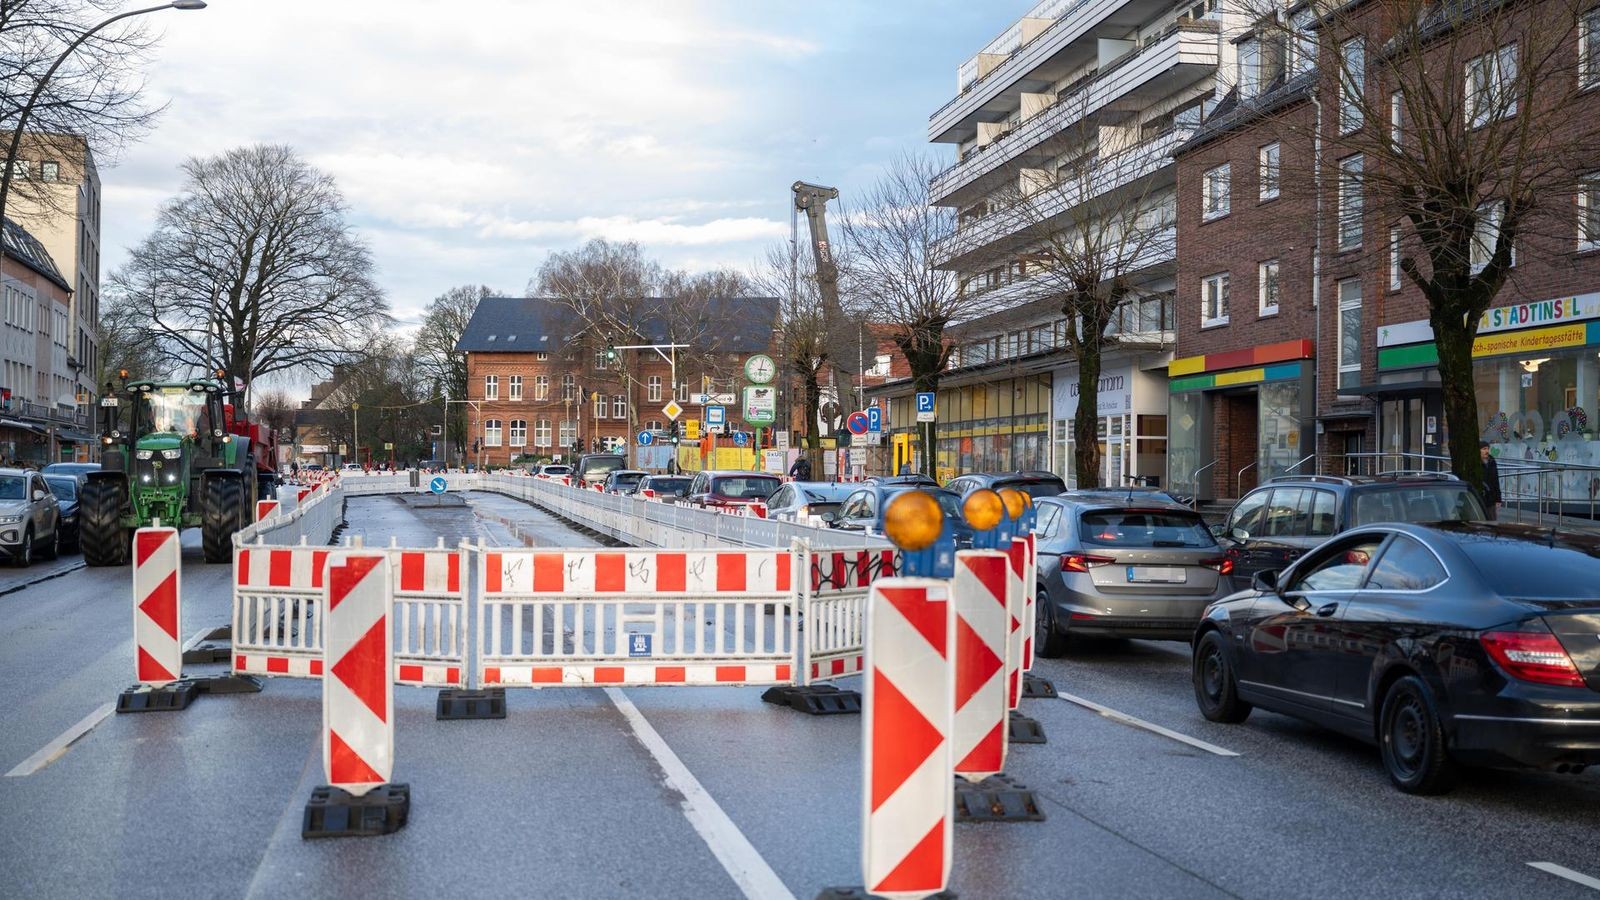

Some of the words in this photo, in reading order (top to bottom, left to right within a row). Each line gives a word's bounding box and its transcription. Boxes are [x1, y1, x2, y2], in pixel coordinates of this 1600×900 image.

[1494, 298, 1581, 327] STADTINSEL
[1473, 339, 1517, 353] sch-spanische
[1520, 330, 1583, 347] Kindertagesstätte
[920, 395, 929, 410] P
[870, 411, 878, 429] P
